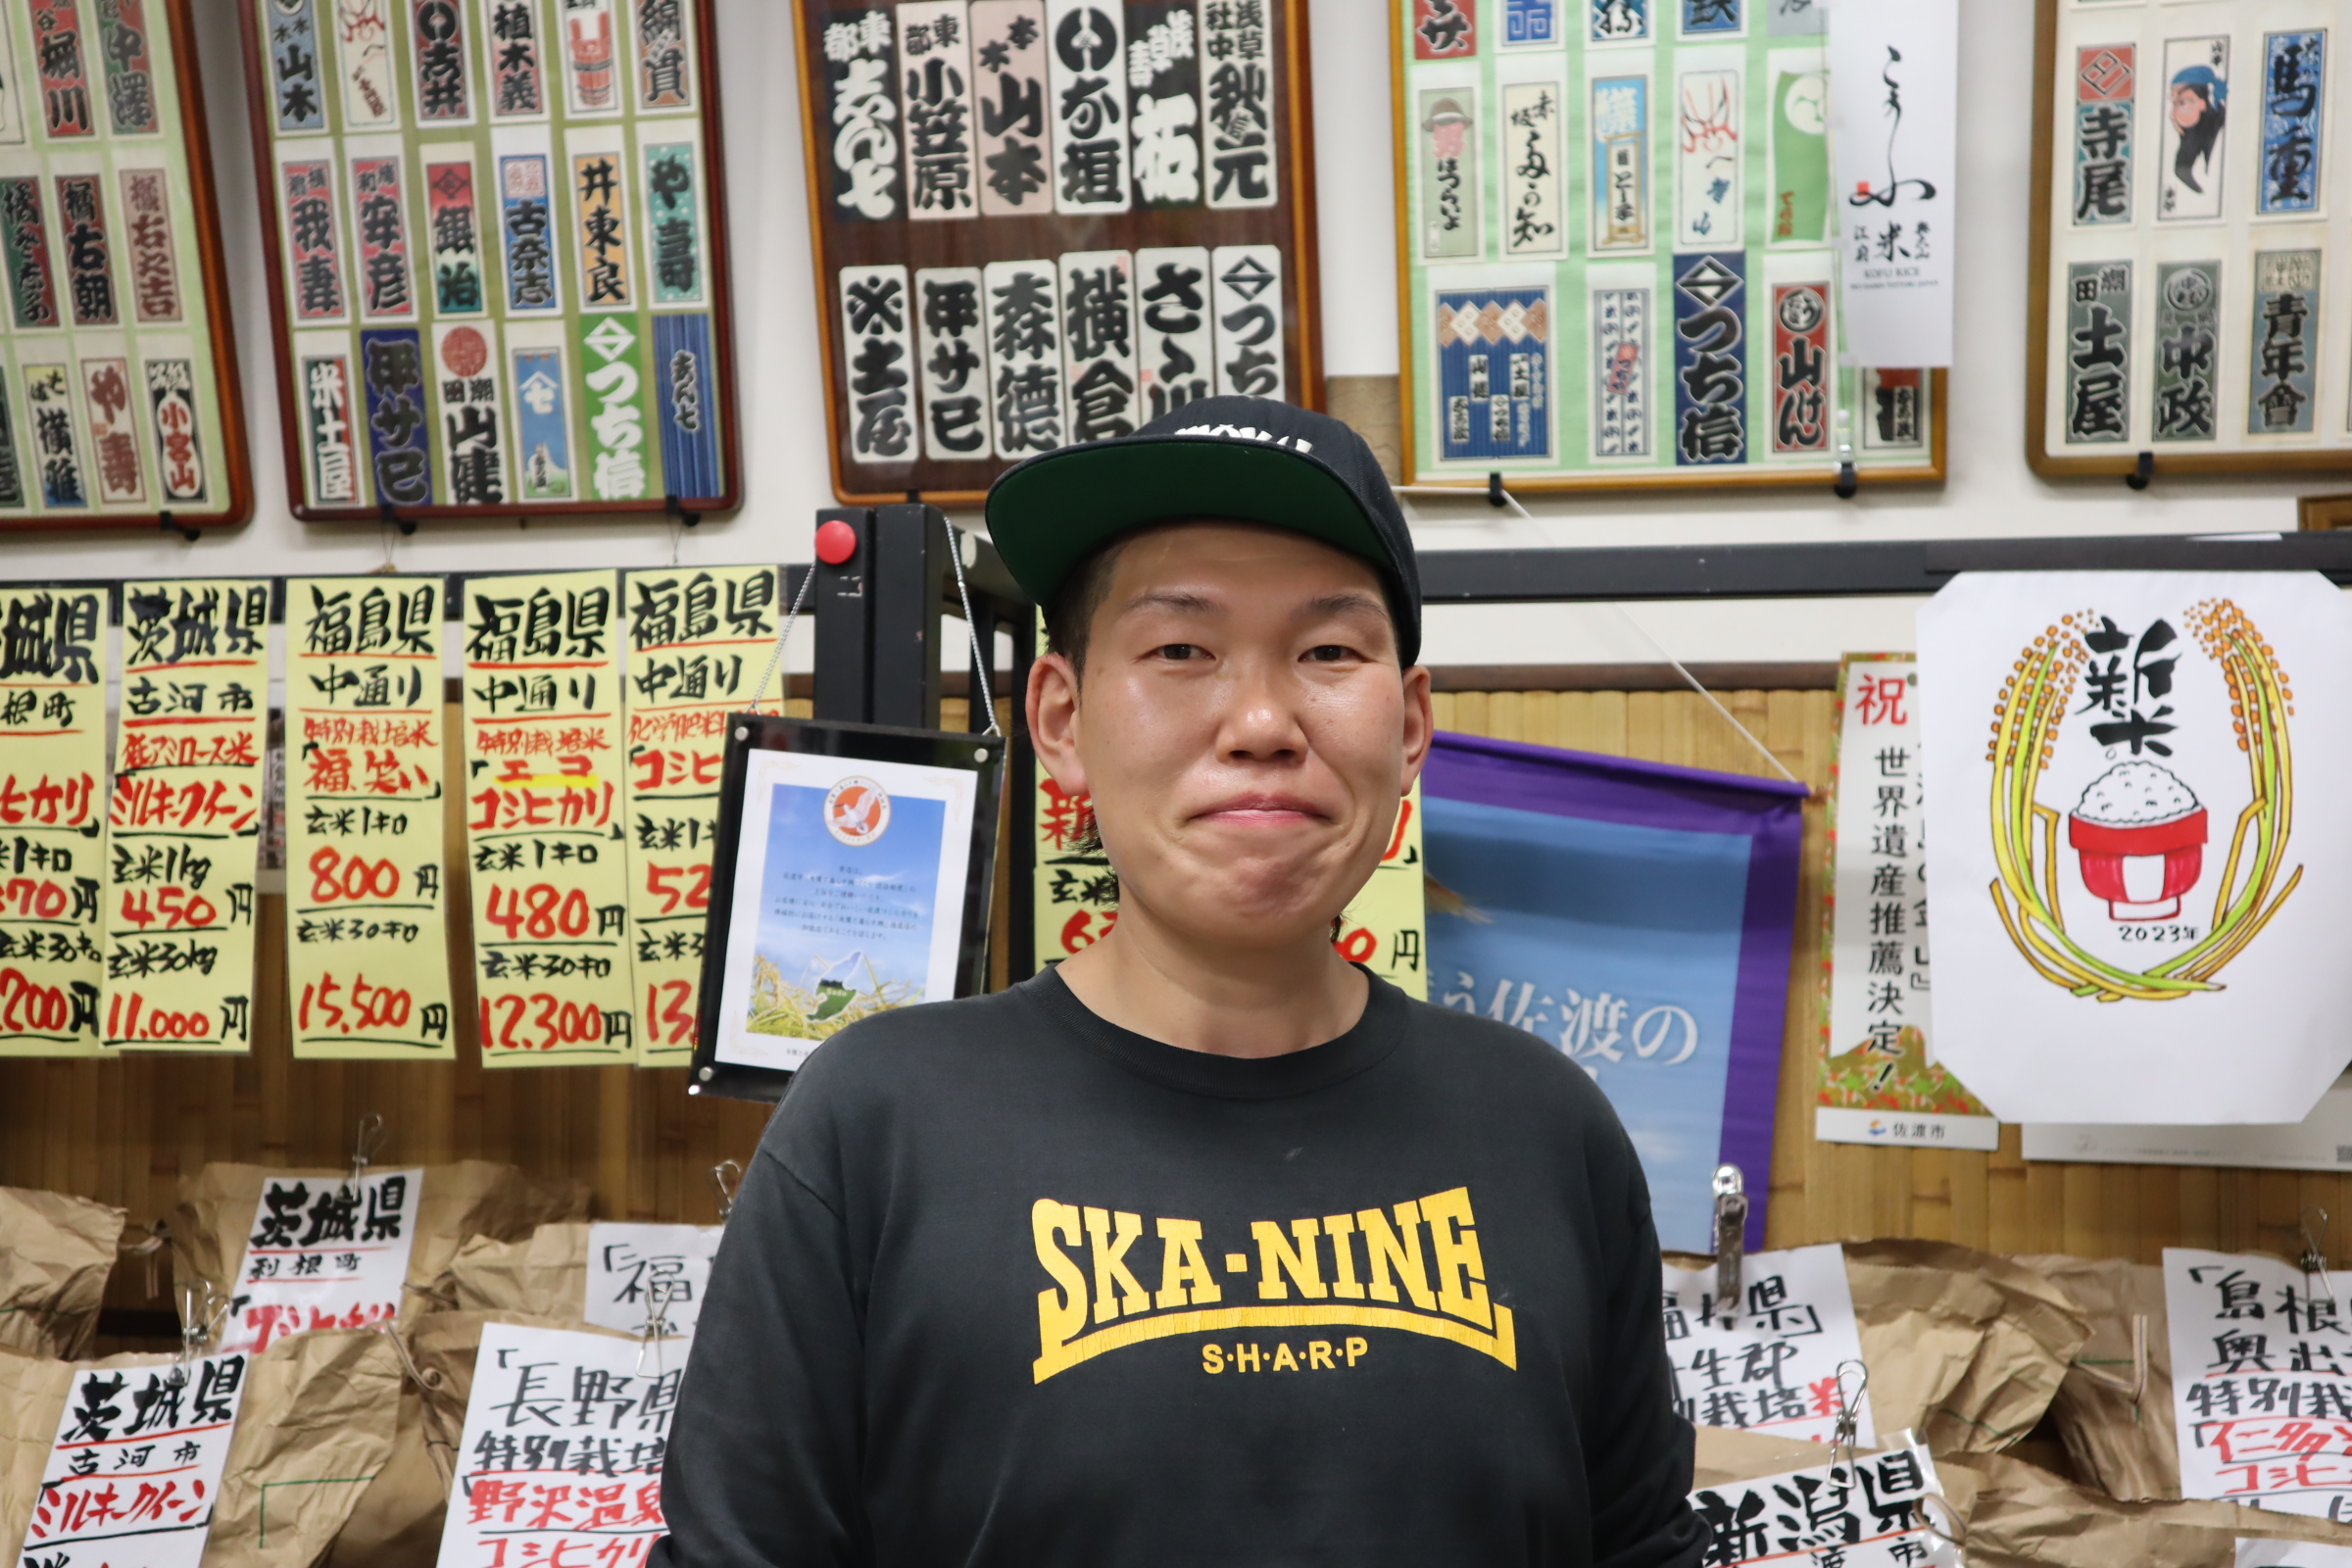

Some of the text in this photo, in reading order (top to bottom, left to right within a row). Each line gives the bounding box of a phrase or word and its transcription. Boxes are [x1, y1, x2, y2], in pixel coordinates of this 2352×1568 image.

[277, 45, 318, 122] 山本
[980, 71, 1048, 206] 山本
[2077, 106, 2128, 220] 寺尾
[293, 198, 339, 313] 我妻
[2071, 305, 2127, 435] 土屋
[161, 401, 196, 490] 小宮山
[126, 586, 268, 665] 茨城県
[304, 584, 435, 655] 福島県
[465, 586, 611, 662] 福島県
[629, 569, 774, 652] 福島県
[126, 676, 255, 715] 古河市
[308, 663, 422, 707] 中通り
[471, 673, 596, 713] 中通り
[632, 654, 743, 704] 中通り
[1855, 673, 1909, 726] 祝
[2075, 615, 2182, 758] 新米
[303, 716, 439, 748] 特別栽培米
[476, 726, 612, 757] 特別栽培米
[2119, 925, 2200, 944] 2023年
[1892, 1122, 1947, 1140] 佐渡市
[249, 1175, 407, 1249] 茨城県
[248, 1251, 363, 1279] 利根町
[2207, 1327, 2352, 1377] 奥出
[60, 1353, 245, 1443] 茨城県
[68, 1440, 202, 1476] 古河市
[1692, 1449, 1936, 1567] 新潟県
